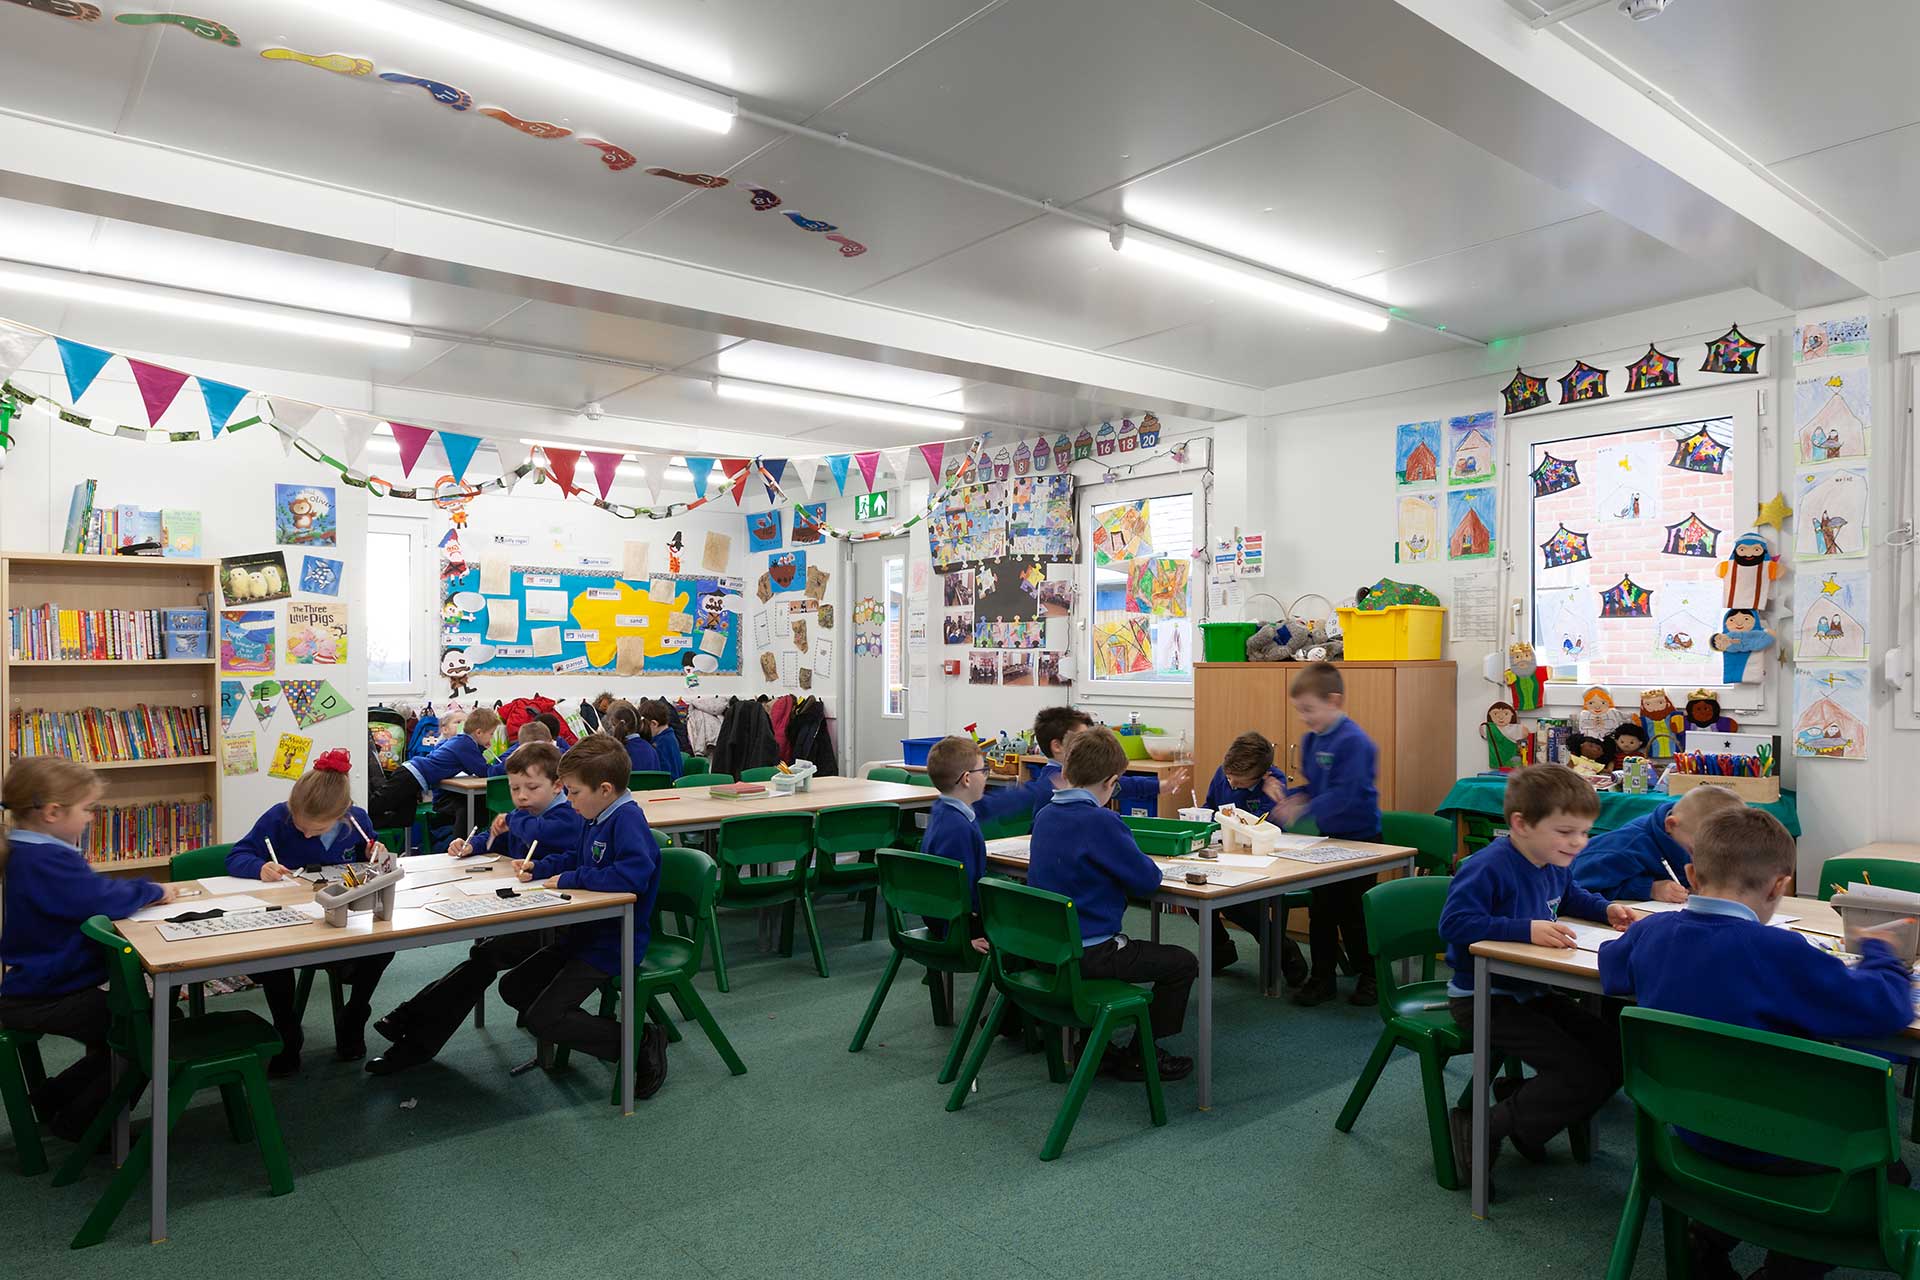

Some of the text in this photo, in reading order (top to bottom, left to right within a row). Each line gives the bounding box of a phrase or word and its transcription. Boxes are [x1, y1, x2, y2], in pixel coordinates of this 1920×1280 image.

[194, 23, 216, 38] 12
[434, 89, 459, 101] 14
[529, 123, 551, 134] 15
[605, 153, 627, 163] 16
[697, 174, 713, 184] 17
[753, 197, 773, 205] 18
[1121, 438, 1134, 450] 18
[1142, 434, 1155, 447] 20
[1078, 446, 1088, 457] 14
[1101, 443, 1111, 454] 16
[1037, 456, 1046, 467] 10
[1058, 452, 1068, 464] 12
[998, 467, 1004, 477] 6
[1019, 462, 1025, 472] 8
[966, 472, 972, 481] 2
[304, 604, 327, 613] Three
[290, 614, 309, 624] Little
[221, 687, 336, 709] R E A D
